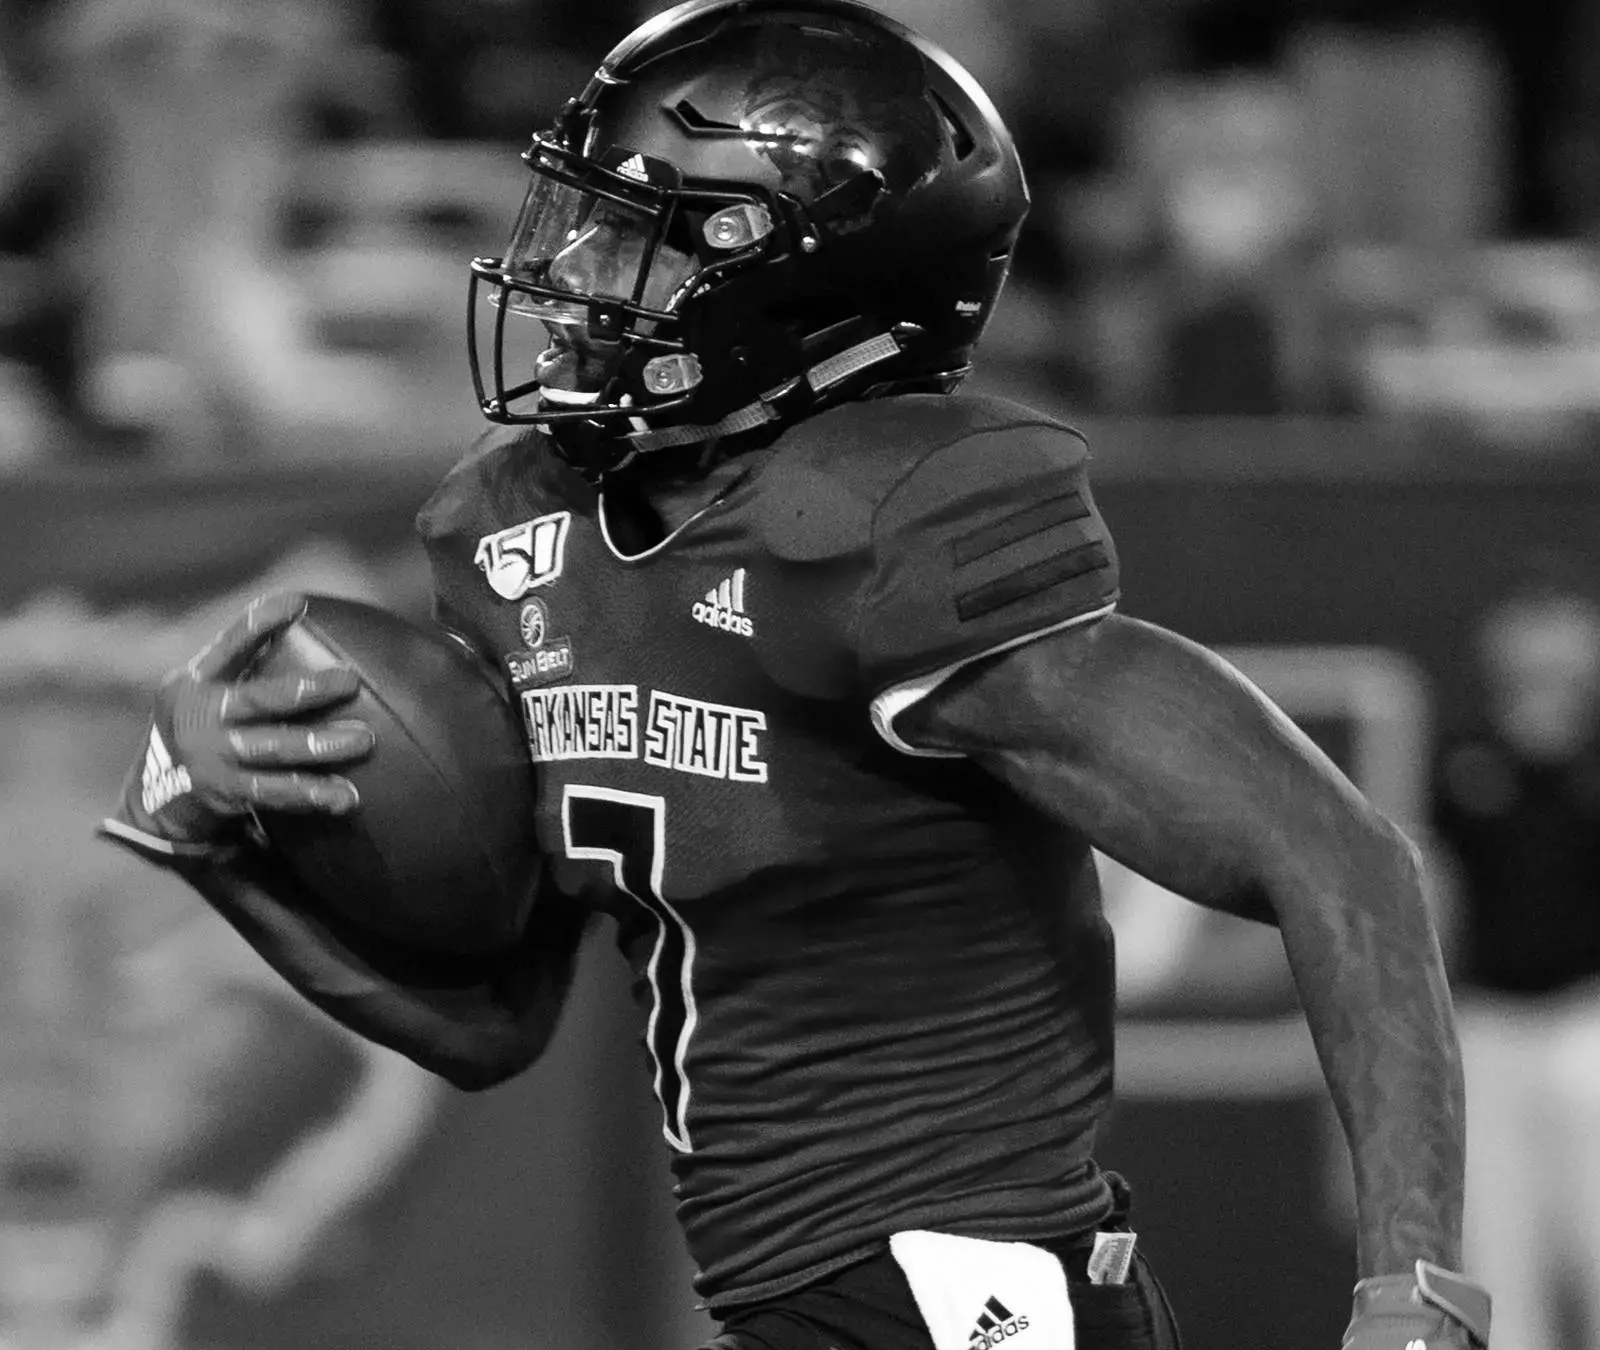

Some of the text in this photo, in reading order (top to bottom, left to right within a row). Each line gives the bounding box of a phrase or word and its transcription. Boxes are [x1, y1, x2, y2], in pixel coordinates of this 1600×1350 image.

[691, 602, 754, 637] adidas
[644, 689, 768, 783] STATE
[561, 784, 696, 1160] 7
